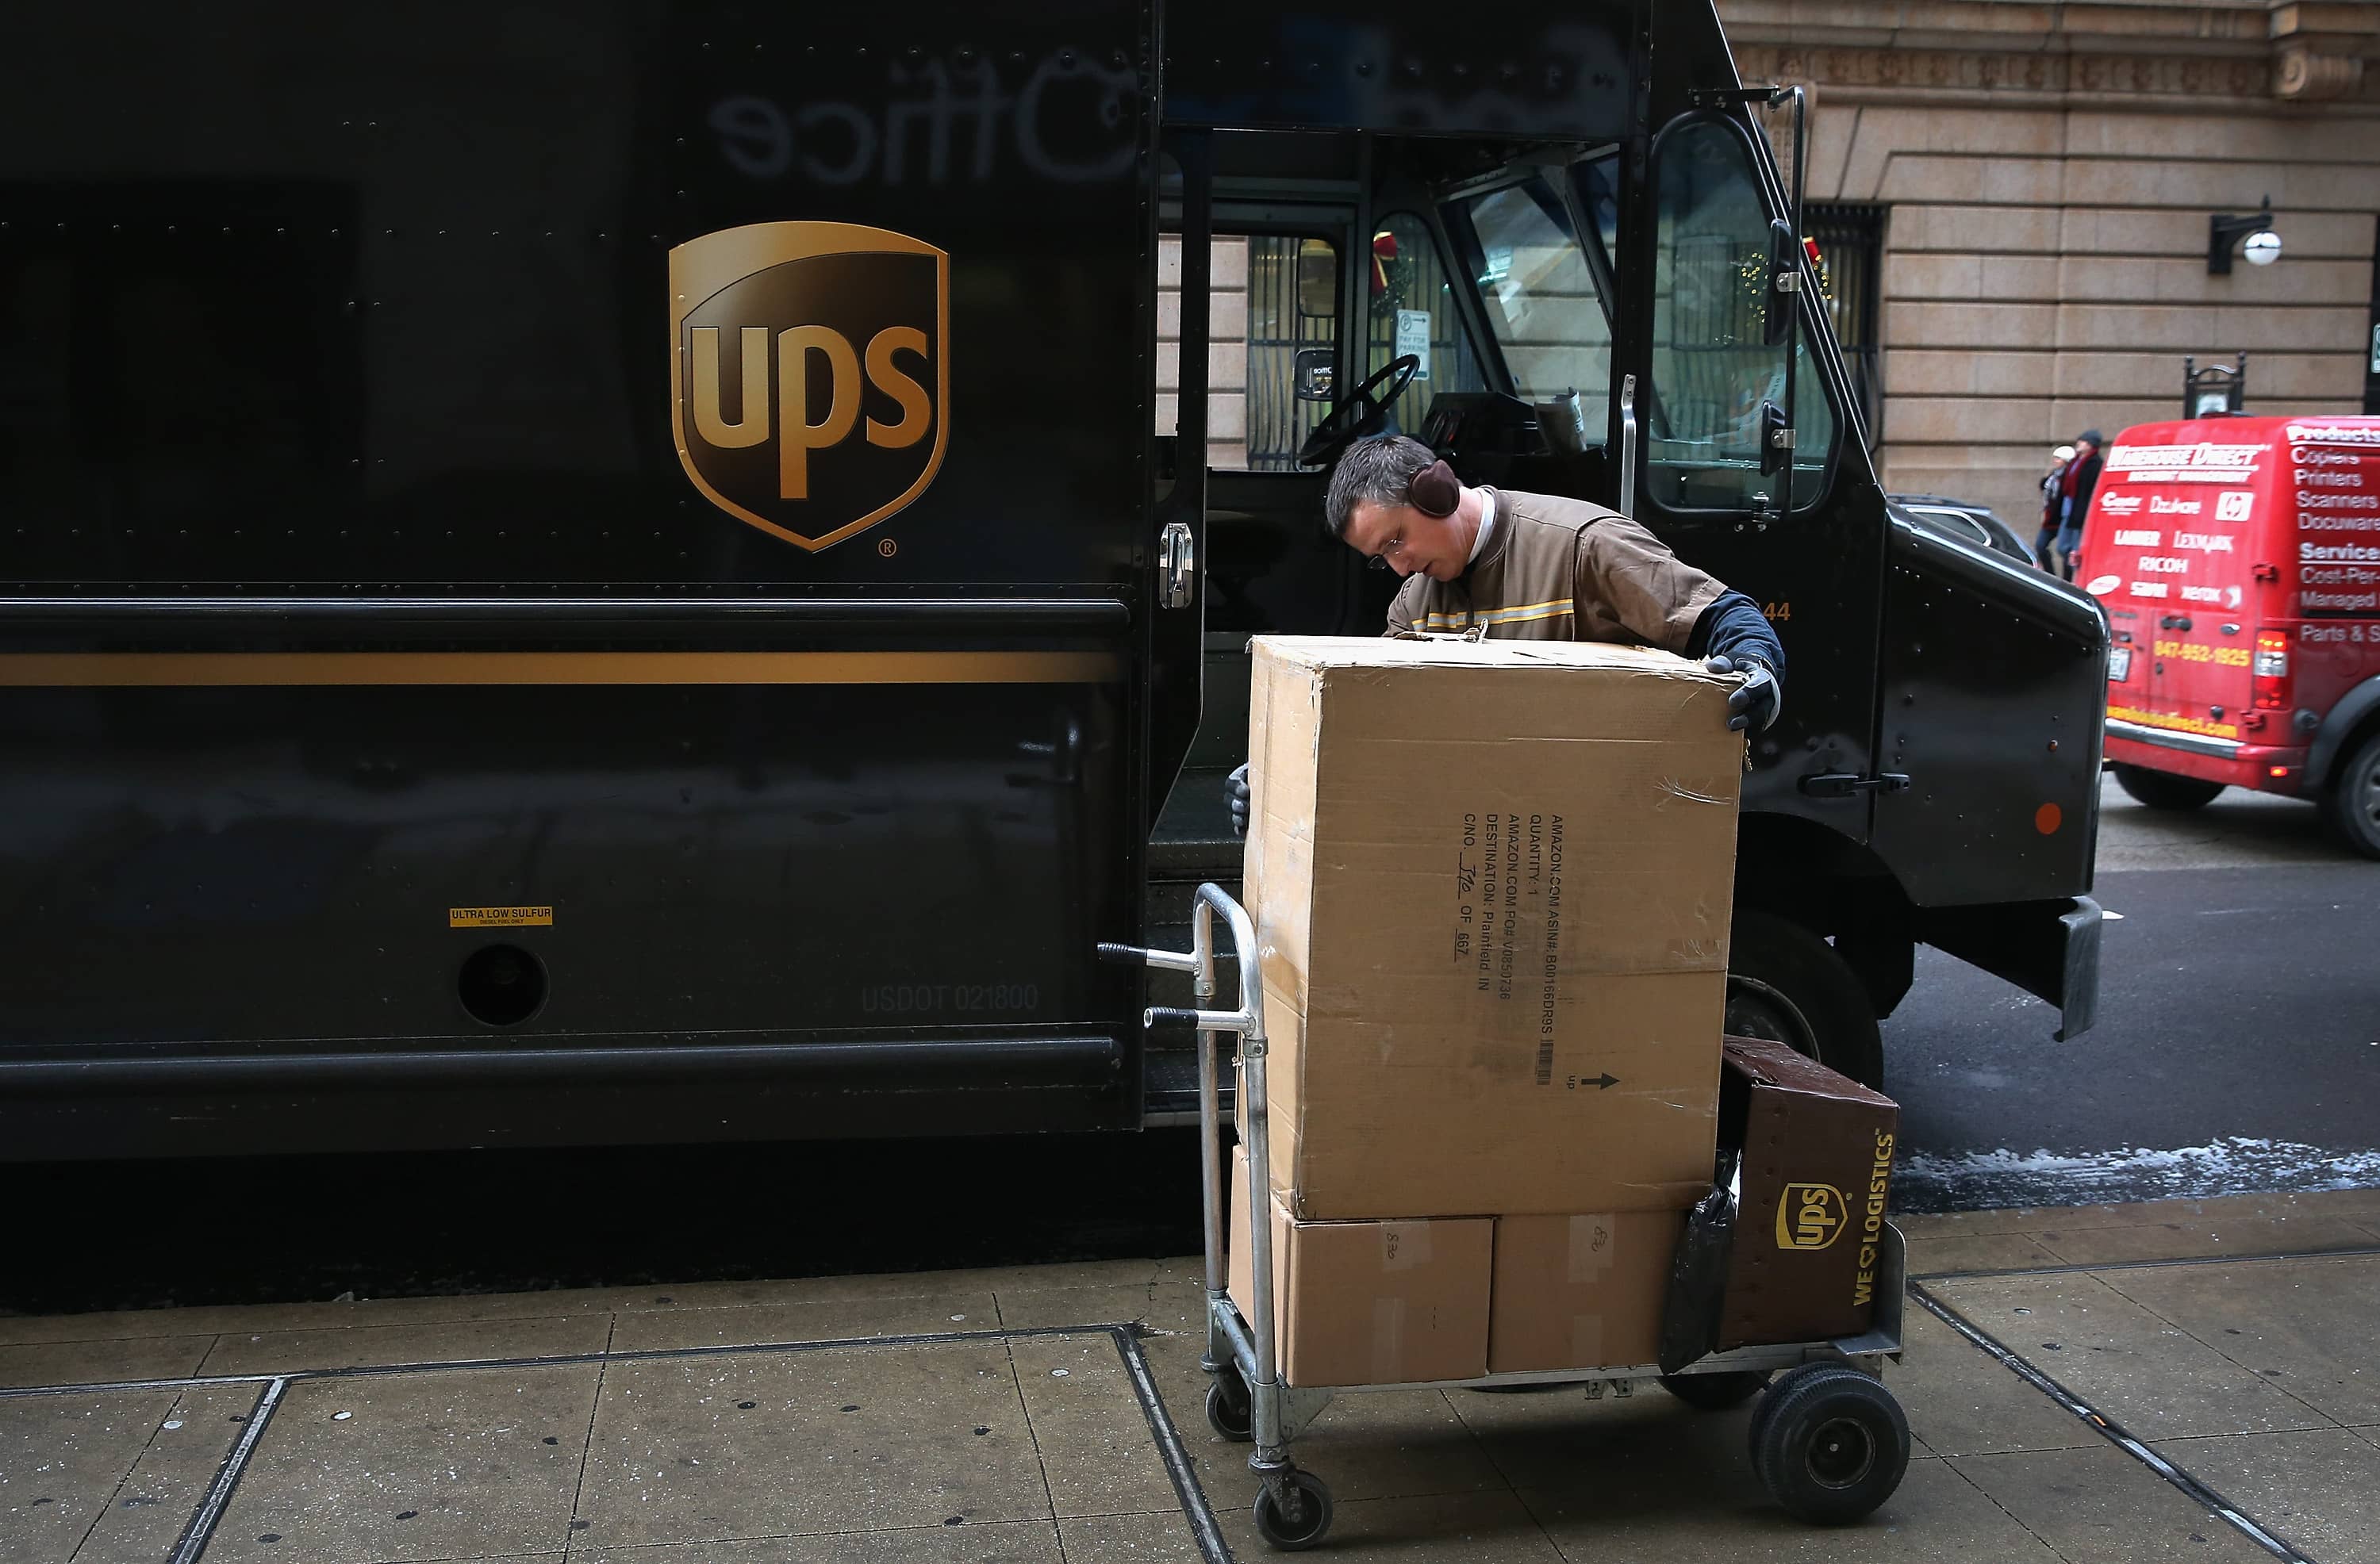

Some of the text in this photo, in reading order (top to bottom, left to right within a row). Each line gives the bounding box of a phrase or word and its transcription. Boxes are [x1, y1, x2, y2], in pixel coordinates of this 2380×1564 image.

[2290, 446, 2361, 467] Copiers
[2293, 468, 2363, 487] Printers
[2296, 489, 2378, 509] Scanners
[2138, 556, 2190, 574] RICOH
[2301, 591, 2376, 611] Managed
[2301, 623, 2347, 642] Parts
[2351, 624, 2363, 642] &
[1463, 813, 1476, 850] C/NO.
[1505, 813, 1520, 907] AMAZON.COM
[1528, 814, 1541, 886] QUANTITY:
[1548, 814, 1563, 907] AMAZON.COM
[1478, 814, 1498, 991] DESTINATION: Plainfield IN
[452, 908, 551, 919] ULTRA LOW SULFUR
[1460, 905, 1472, 924] OF
[1546, 910, 1559, 953] ASIN#:
[1457, 933, 1470, 955] 667
[861, 985, 947, 1012] USDOT
[1566, 1075, 1576, 1090] up
[1852, 1271, 1873, 1306] WE
